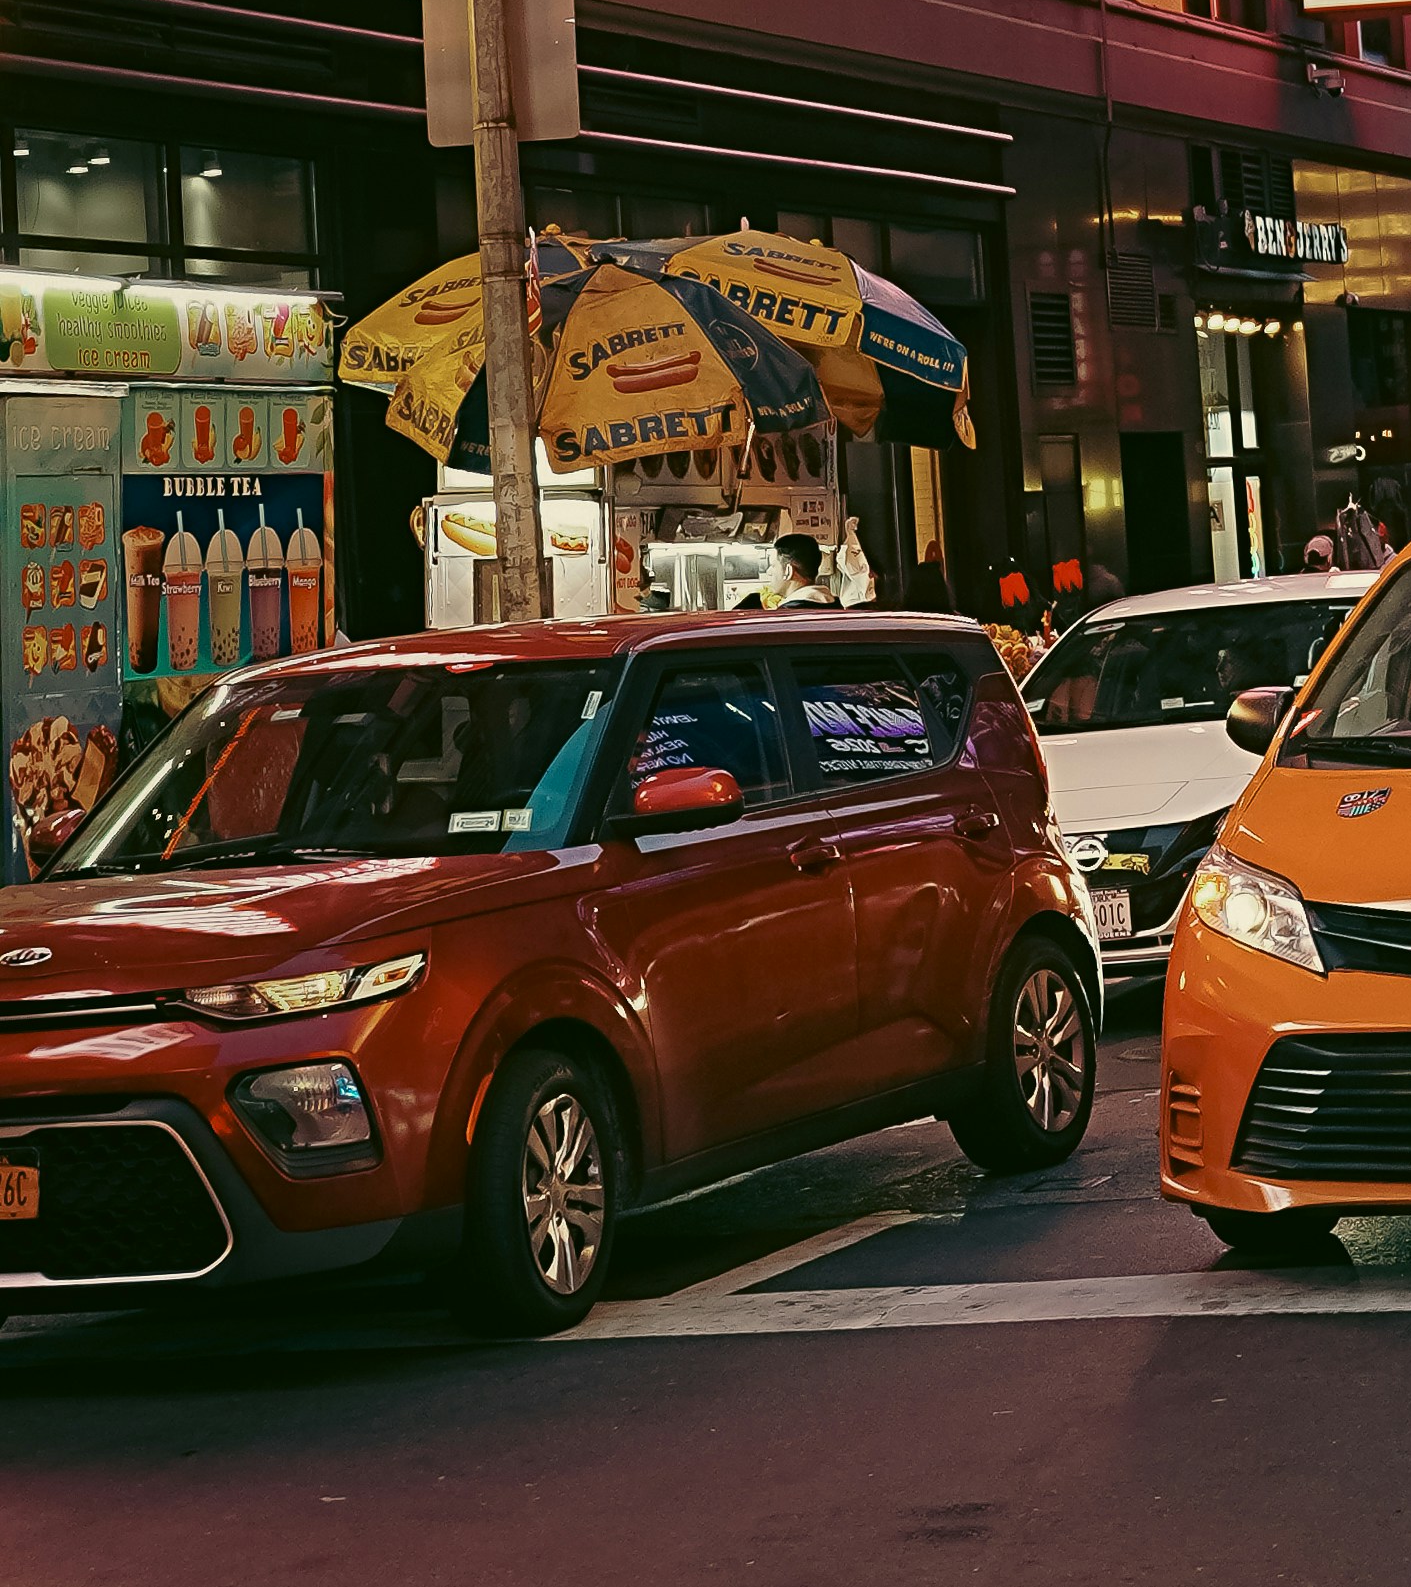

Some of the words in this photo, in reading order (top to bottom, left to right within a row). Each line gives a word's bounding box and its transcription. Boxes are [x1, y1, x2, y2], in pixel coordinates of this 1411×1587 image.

[1255, 215, 1286, 257] BEN
[1296, 221, 1348, 262] JERRY'S
[722, 240, 842, 272] SABRETT
[399, 277, 482, 308] SABRE
[57, 314, 104, 344] healthy
[107, 317, 168, 342] smoothies
[78, 344, 100, 367] ice
[105, 348, 151, 370] cream
[568, 323, 688, 381] SABRETT
[917, 353, 941, 370] ROLL
[12, 425, 43, 452] ice
[51, 424, 111, 453] cream
[553, 403, 737, 463] SABRETT
[163, 477, 225, 497] BUBBLE
[230, 477, 262, 497] TEA
[147, 574, 160, 586] Tea
[162, 581, 202, 596] Strawberry
[249, 574, 282, 588] Blueberry
[292, 576, 317, 588] Mango
